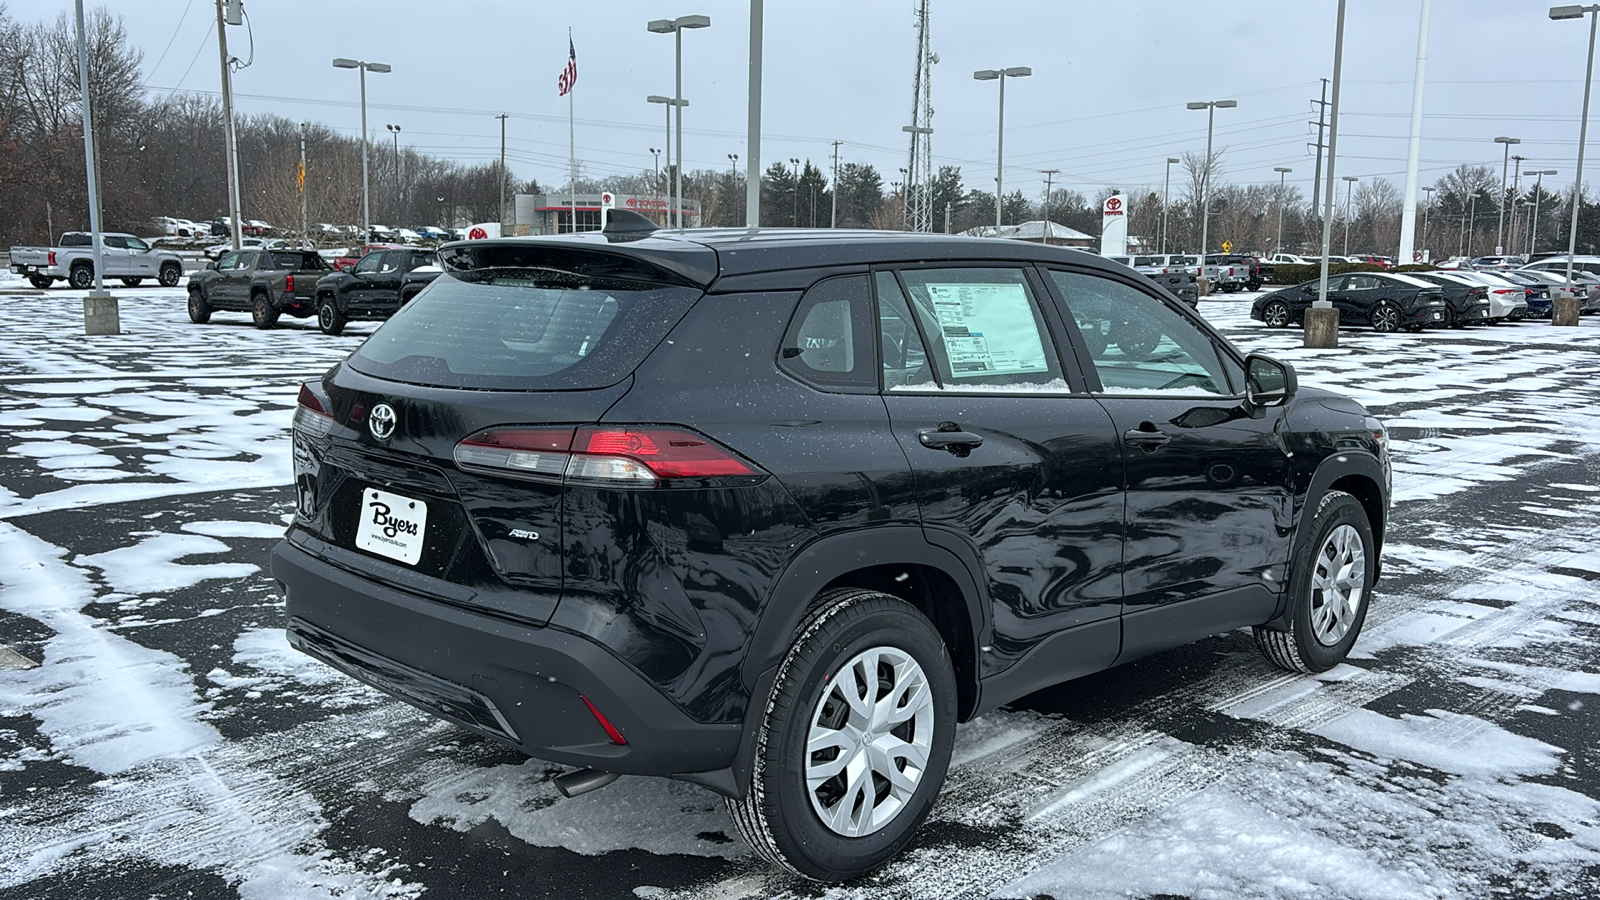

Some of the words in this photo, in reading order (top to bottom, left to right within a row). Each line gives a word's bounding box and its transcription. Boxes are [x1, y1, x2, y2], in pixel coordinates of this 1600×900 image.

[638, 199, 667, 207] TOYOTA
[369, 501, 418, 538] Byers
[371, 533, 407, 549] www.byersauto.com
[508, 528, 539, 540] AWD
